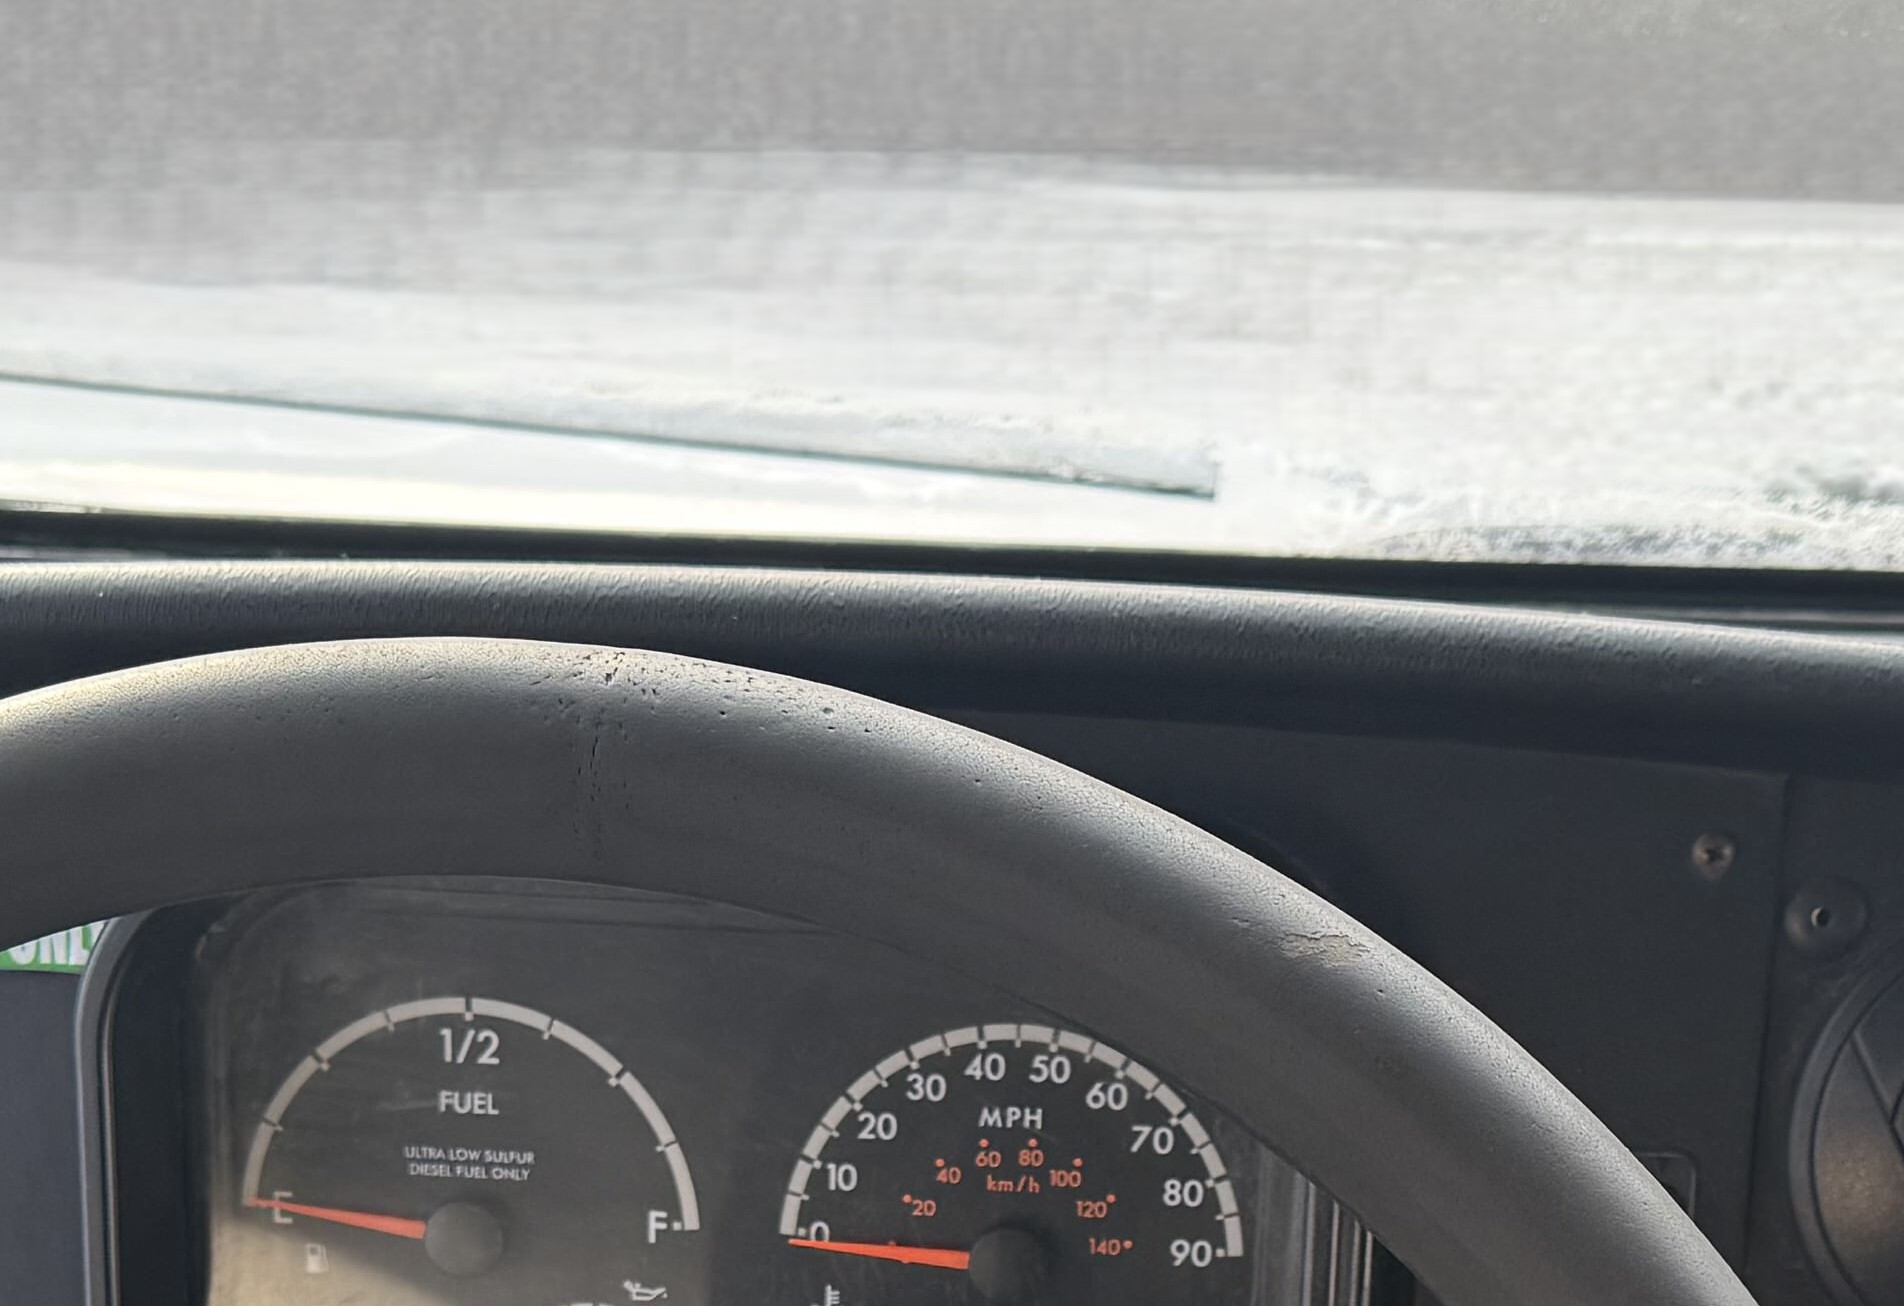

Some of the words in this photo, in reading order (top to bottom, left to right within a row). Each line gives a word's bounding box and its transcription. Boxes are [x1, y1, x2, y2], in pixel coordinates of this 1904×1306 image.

[439, 1028, 500, 1065] 1/2
[964, 1053, 1005, 1081] 40
[1029, 1055, 1071, 1085] 50
[906, 1073, 946, 1102] 30
[1086, 1082, 1128, 1111] 60
[438, 1091, 500, 1116] FUEL
[857, 1113, 897, 1141] 20
[978, 1107, 1043, 1130] MPH
[1130, 1125, 1174, 1155] 70
[404, 1146, 445, 1161] ULTRA
[447, 1147, 481, 1163] LOW
[483, 1148, 536, 1166] SULFUR
[975, 1151, 1001, 1168] 60
[1018, 1150, 1044, 1167] 80
[409, 1163, 452, 1178] DIESEL
[455, 1164, 489, 1180] FUEL
[491, 1165, 531, 1182] ONLY
[827, 1163, 857, 1191] 10
[936, 1167, 961, 1185] 40
[986, 1174, 1040, 1194] km/h
[1049, 1170, 1081, 1188] 100
[1163, 1180, 1204, 1208] 80
[912, 1199, 936, 1217] 20
[1076, 1201, 1107, 1218] 120
[647, 1210, 669, 1244] F
[809, 1221, 830, 1243] 0
[1088, 1239, 1121, 1256] 140
[1170, 1239, 1212, 1267] 90
